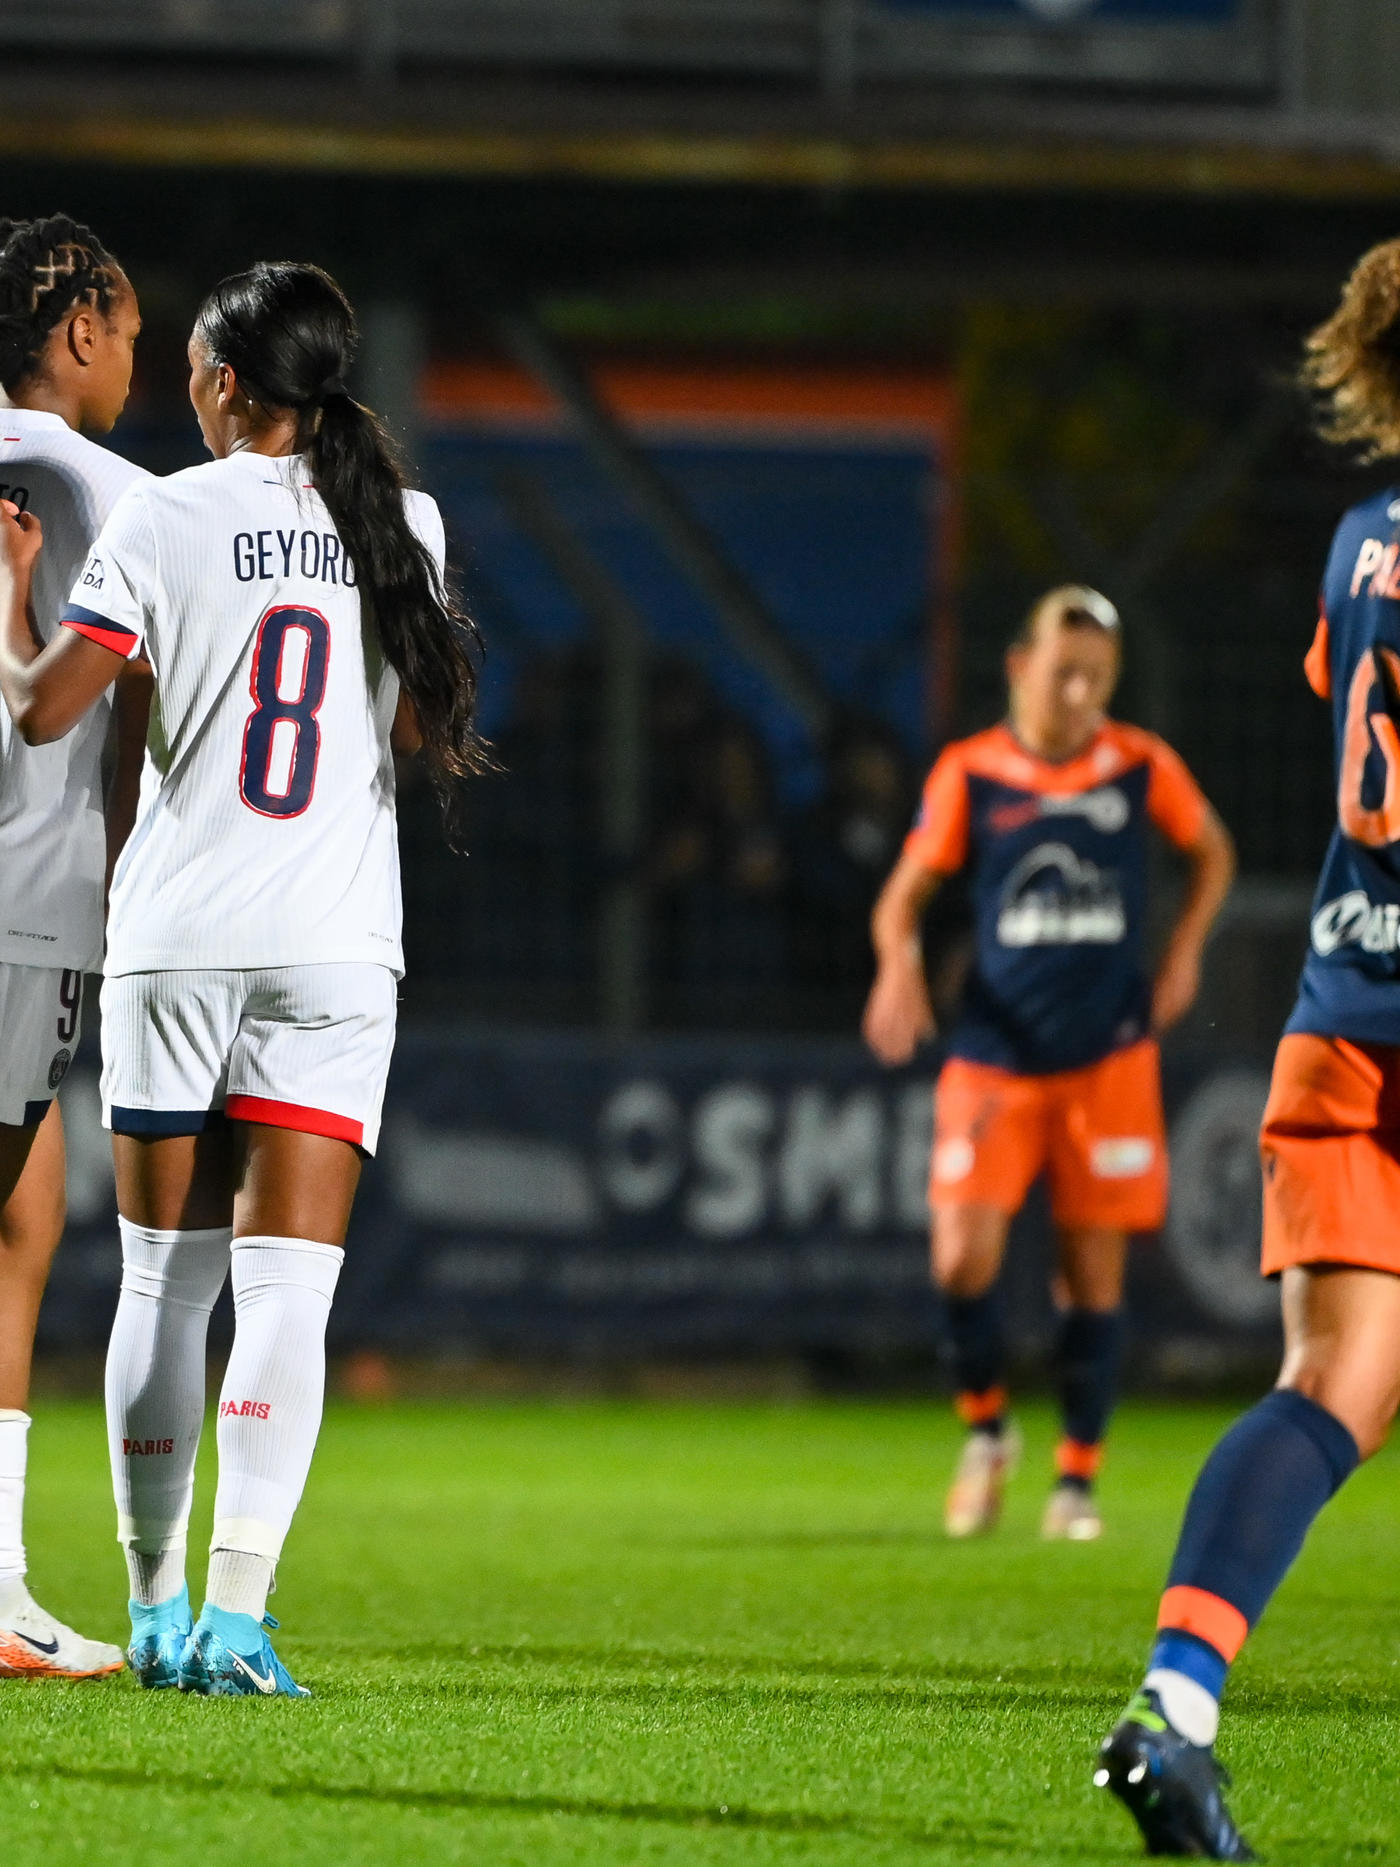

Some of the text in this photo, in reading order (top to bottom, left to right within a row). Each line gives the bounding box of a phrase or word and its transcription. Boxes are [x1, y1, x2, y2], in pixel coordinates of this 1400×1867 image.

[239, 604, 331, 820] 8
[57, 968, 80, 1043] 9
[219, 1400, 273, 1421] PARIS
[122, 1438, 174, 1456] PARIS
